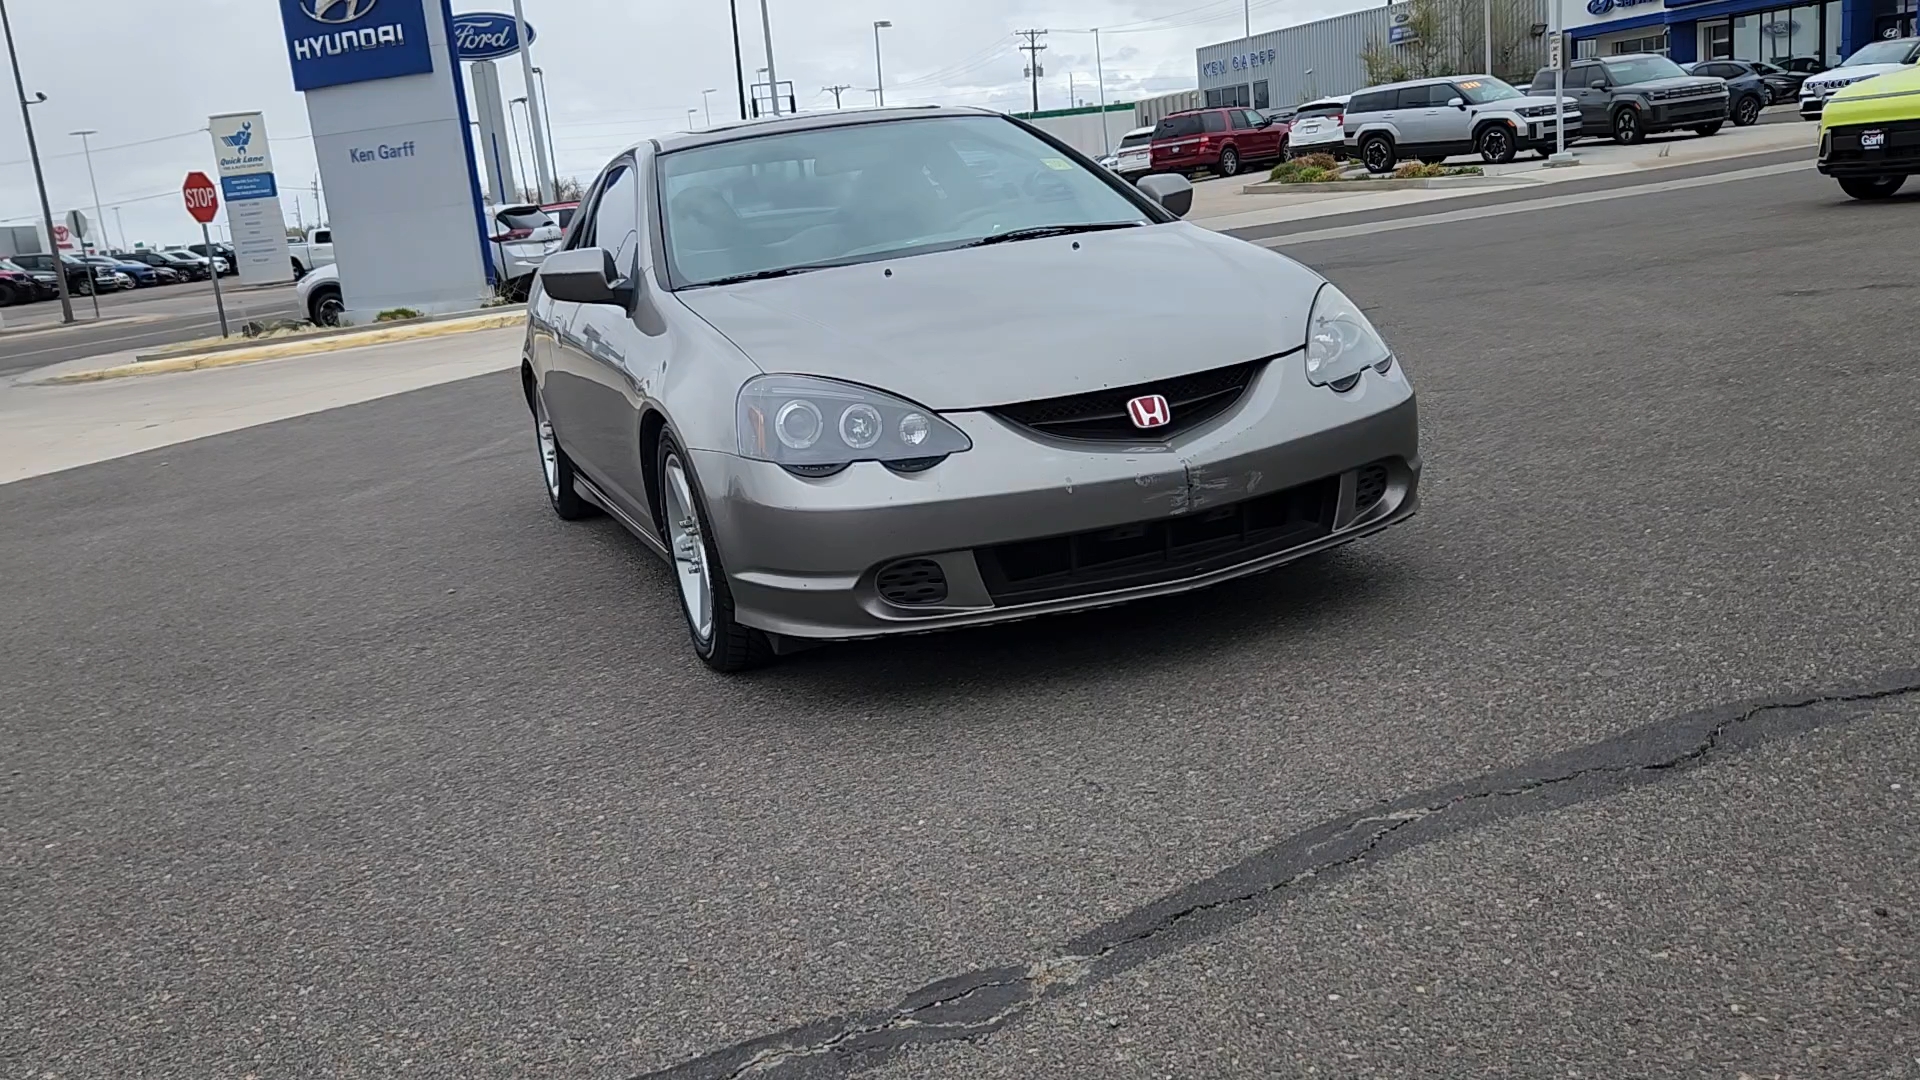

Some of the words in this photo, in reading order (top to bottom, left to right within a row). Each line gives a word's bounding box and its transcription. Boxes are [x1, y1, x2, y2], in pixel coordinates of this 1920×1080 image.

[294, 23, 404, 61] HYUNDAI
[454, 21, 510, 49] Ford
[1203, 60, 1226, 77] KEN
[1553, 53, 1558, 68] 5
[220, 156, 241, 166] Quick
[349, 147, 375, 163] Ken
[378, 141, 415, 160] Garff
[185, 187, 215, 208] STOP
